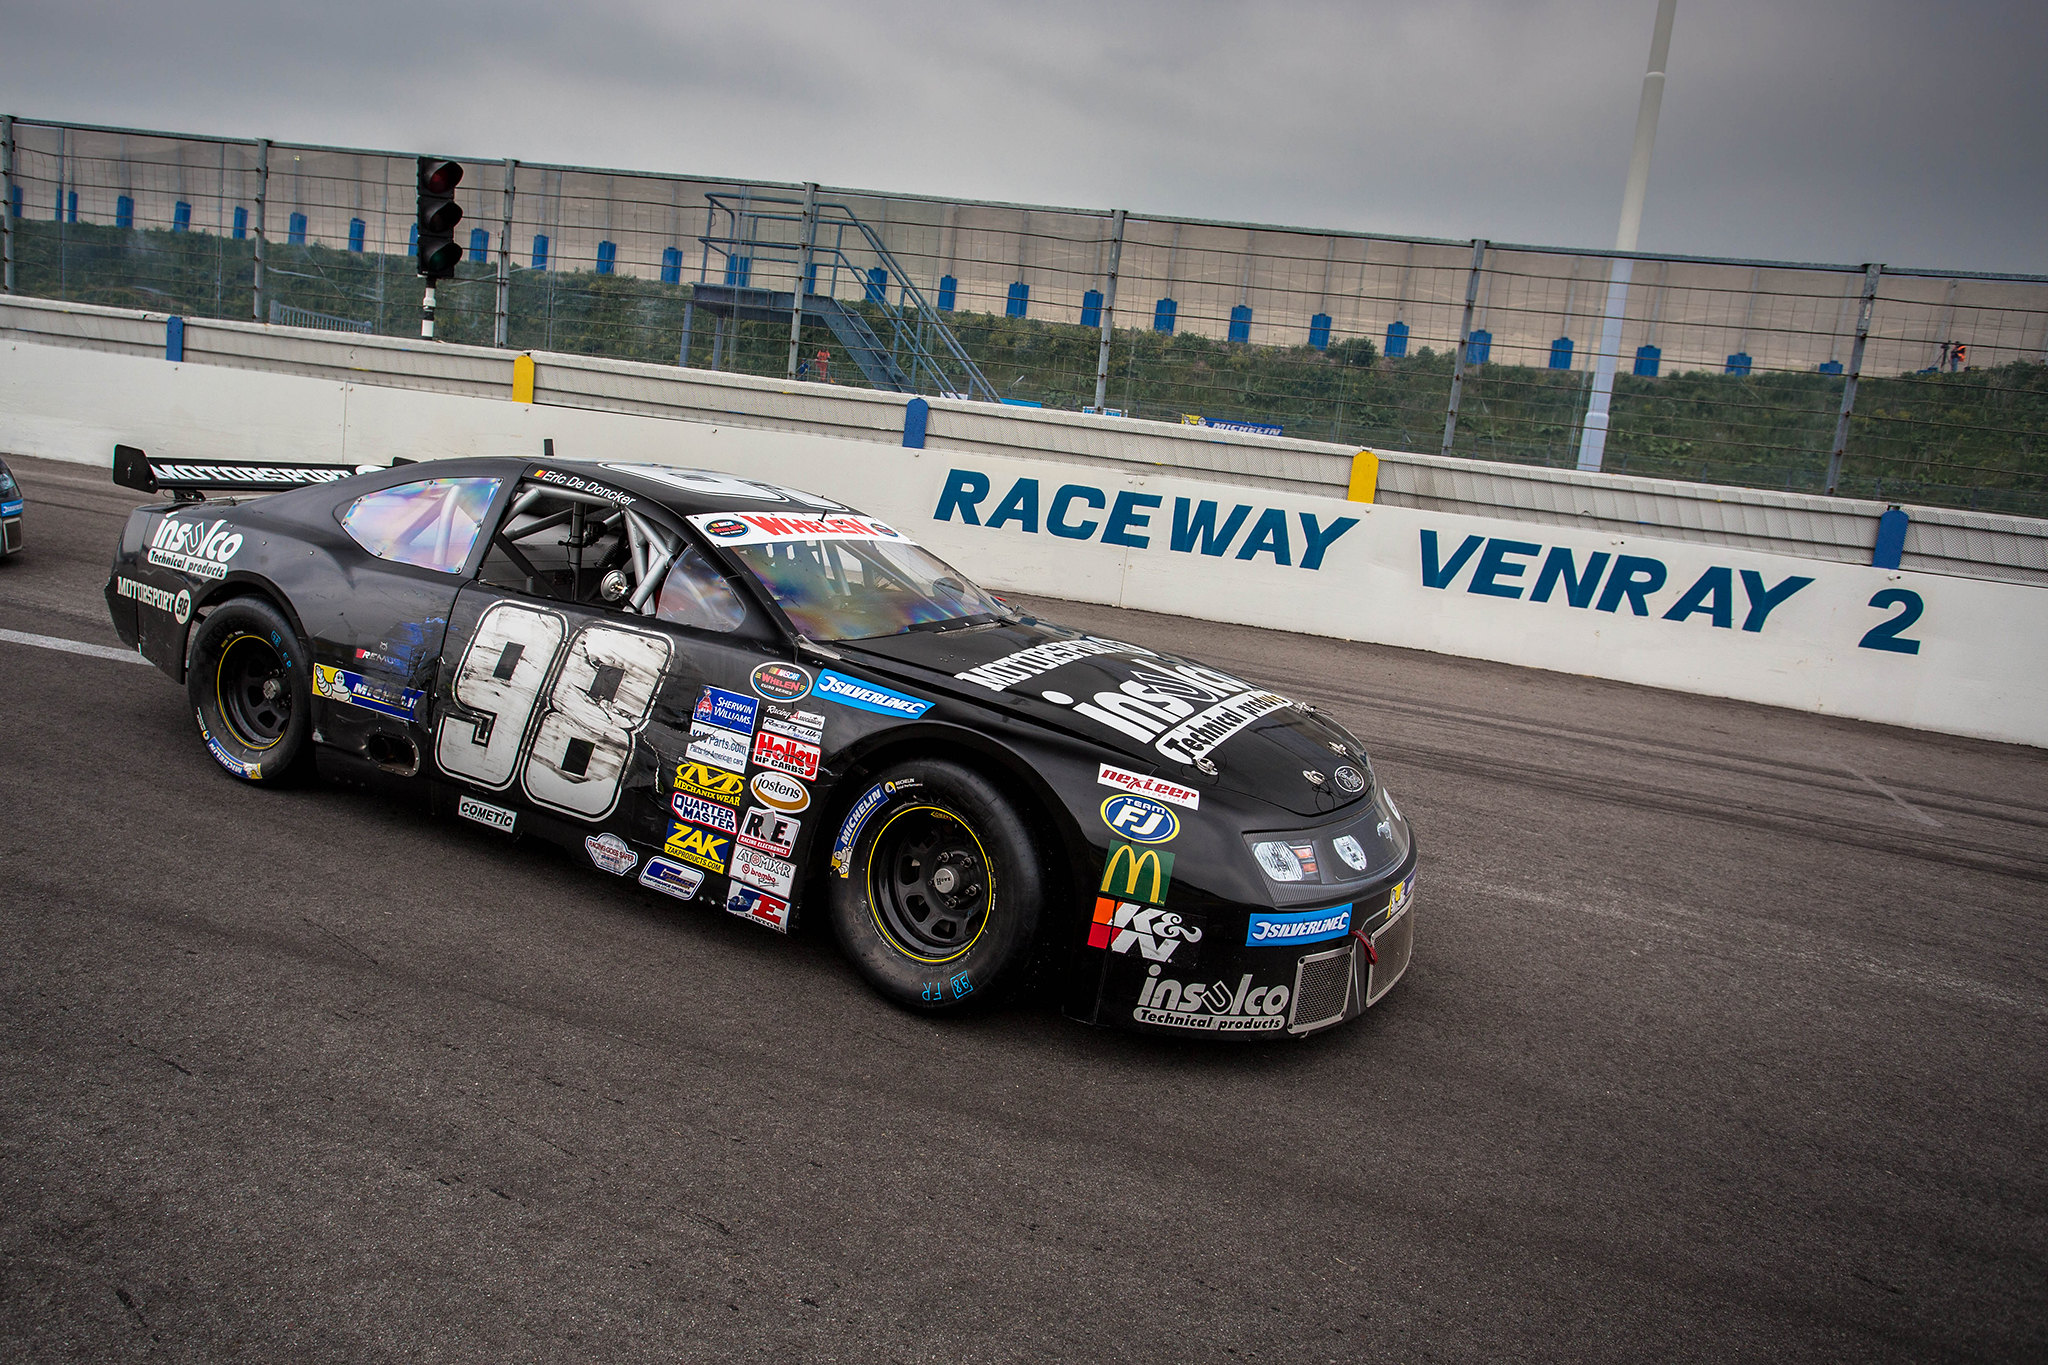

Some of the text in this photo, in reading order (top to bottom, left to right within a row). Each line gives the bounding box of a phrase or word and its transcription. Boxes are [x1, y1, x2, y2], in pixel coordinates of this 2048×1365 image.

[542, 470, 567, 485] Eric
[584, 481, 637, 506] Doncker
[151, 510, 244, 563] insulco
[740, 514, 881, 537] WHELEN
[150, 549, 224, 578] Technical products
[933, 468, 1360, 571] RACEWAY
[1419, 528, 1816, 632] VENRAY
[1858, 588, 1925, 655] 2
[117, 575, 189, 617] MOTORSPORT 98
[761, 671, 801, 692] WHELEN
[435, 599, 676, 823] 98
[716, 696, 754, 715] SHERWIN
[766, 705, 792, 719] Racing
[1163, 705, 1248, 759] Technical
[208, 743, 243, 775] MICHELIN
[754, 755, 805, 775] HP CARBS
[756, 733, 819, 777] Holley
[673, 777, 741, 807] MECHANIX WEAR
[756, 773, 801, 799] jostens
[1101, 769, 1197, 800] nexteer
[461, 802, 514, 827] COMETIC
[673, 793, 734, 821] QUARTER
[682, 806, 735, 832] MASTER
[841, 788, 882, 846] MICHELIN
[1112, 804, 1165, 836] FJ
[1125, 797, 1166, 815] TEAM
[667, 845, 722, 872] ZAKPRODUCTS.COM
[1137, 963, 1290, 1016] insulco
[1140, 1009, 1281, 1030] Technical products
